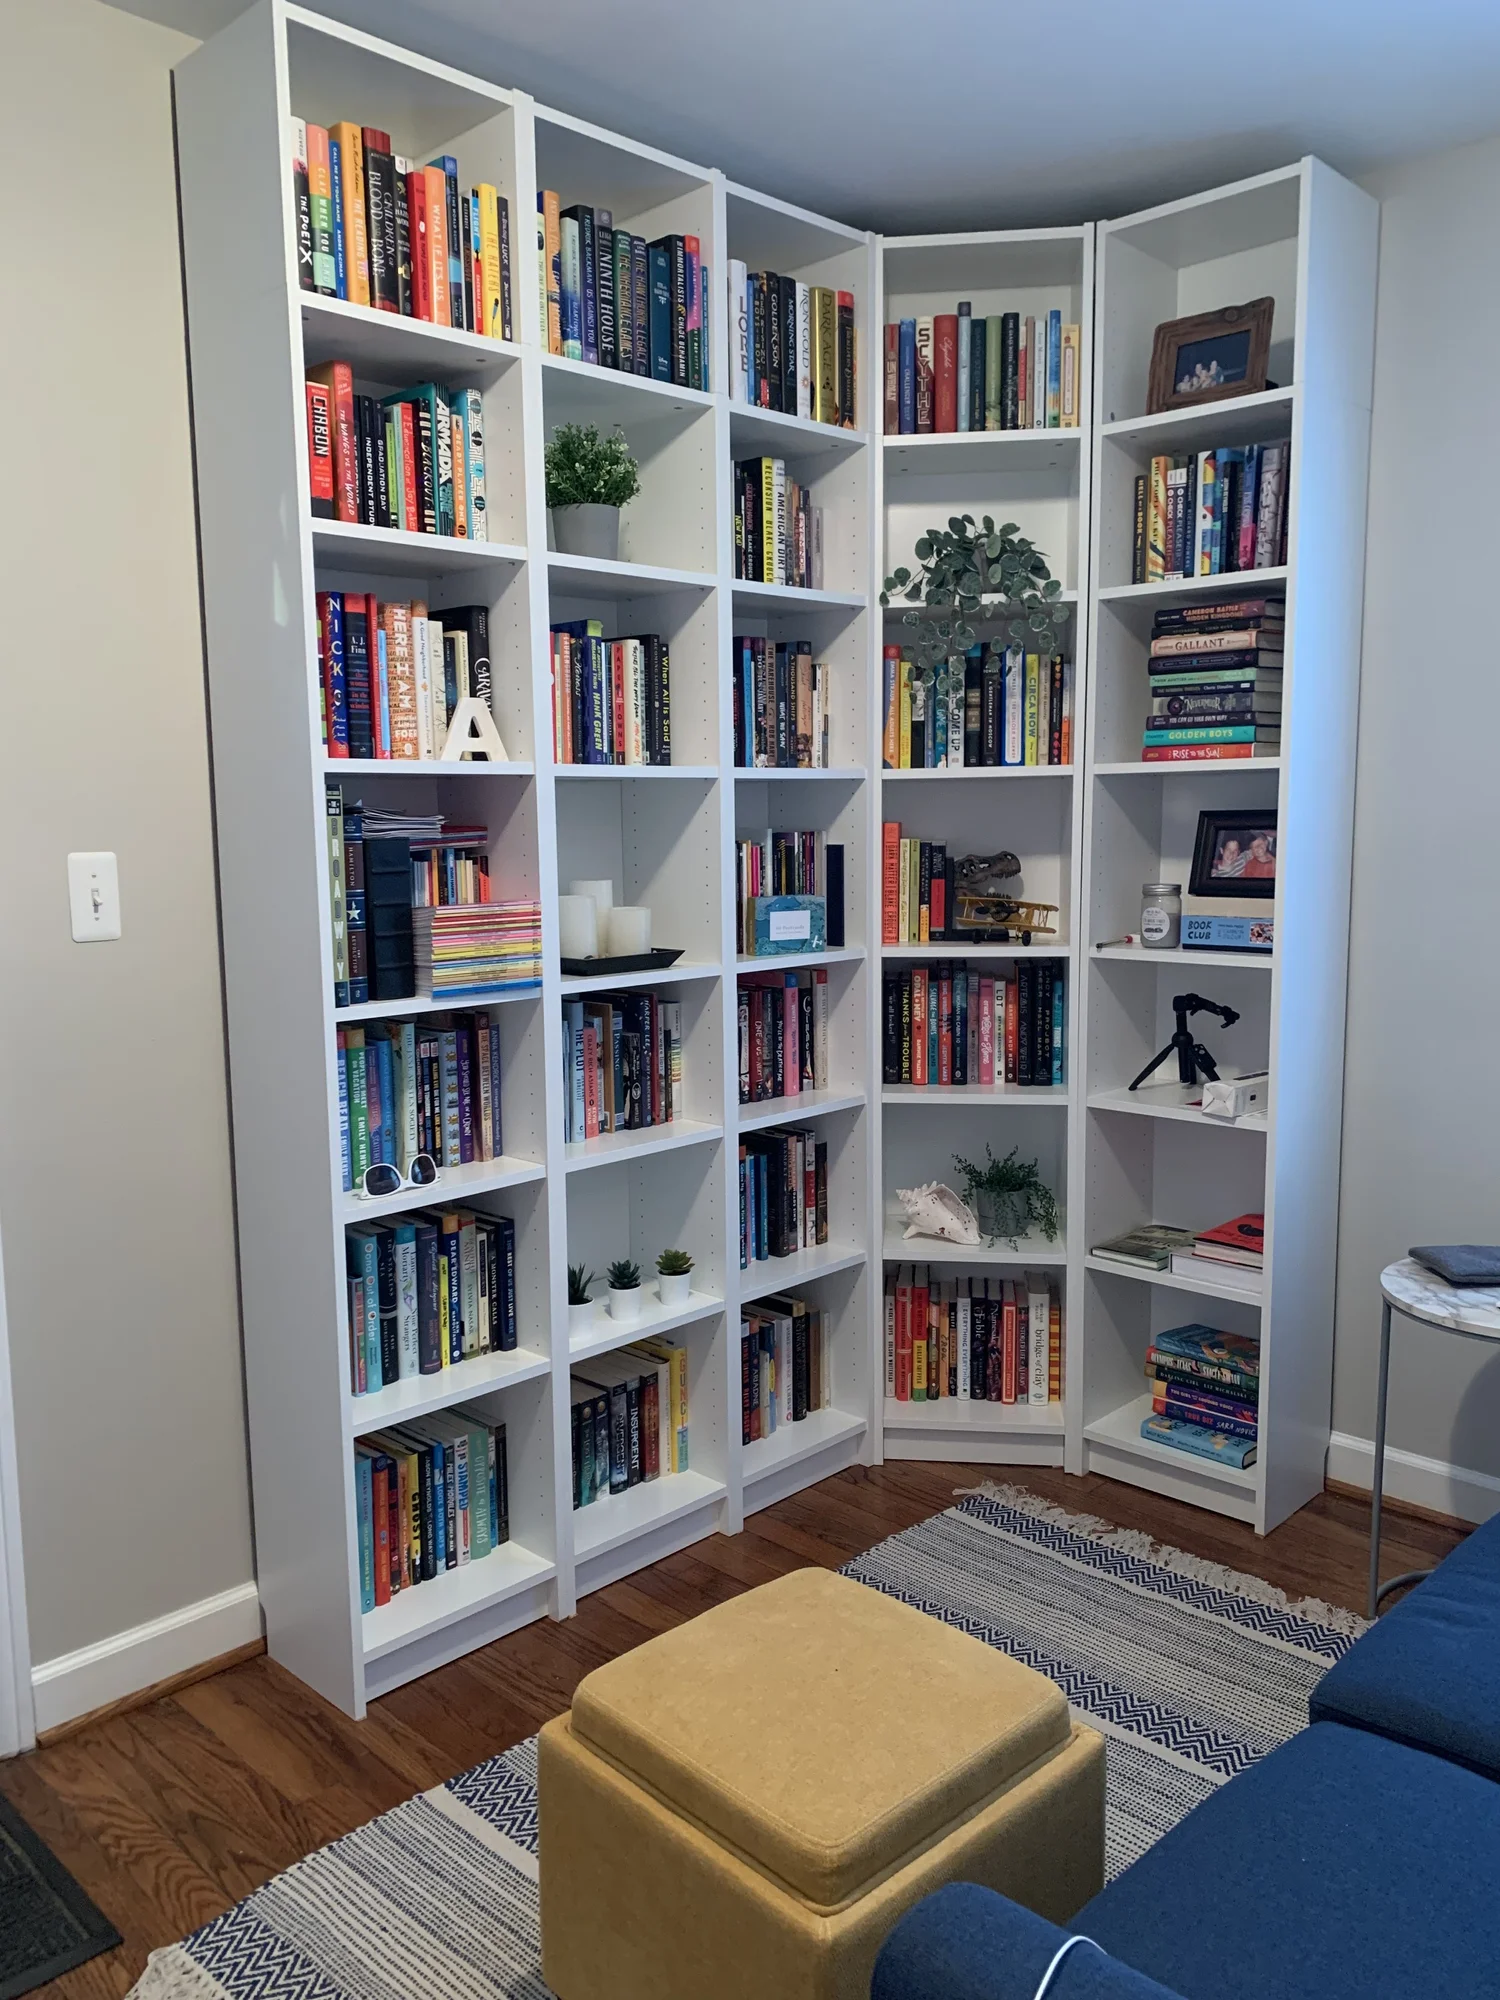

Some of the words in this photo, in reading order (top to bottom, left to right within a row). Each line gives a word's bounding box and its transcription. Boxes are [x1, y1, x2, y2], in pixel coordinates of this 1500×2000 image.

[300, 196, 308, 212] THE
[354, 199, 362, 217] THE
[300, 215, 311, 247] POET
[355, 219, 365, 258] READING
[299, 246, 313, 265] X
[357, 261, 367, 281] LIST
[600, 251, 613, 298] NINTH
[677, 247, 685, 303] IMMORTALISTS
[800, 288, 809, 326] IRON
[822, 293, 832, 334] DARK
[601, 304, 614, 353] HOUSE
[737, 295, 748, 372] LORE
[787, 299, 795, 348] MORNING
[787, 349, 795, 374] STAR
[801, 328, 809, 369] GOLD
[822, 340, 832, 372] AGE
[917, 328, 931, 424] SCYTHE
[313, 395, 330, 456] CHABON
[436, 397, 452, 485] ARMADA
[366, 437, 374, 498] INDEPENDENT
[377, 439, 385, 492] GRADUATION
[421, 441, 433, 504] BLACKOUT
[765, 465, 773, 512] RECURSION
[777, 492, 785, 545] AMERICAN
[1153, 512, 1159, 525] WE
[766, 551, 774, 583] CROUCH
[778, 548, 786, 570] DIRT
[1183, 607, 1215, 617] CAMERON
[1217, 605, 1239, 613] BATTLE
[394, 608, 408, 658] HERE
[1174, 638, 1225, 652] GALLANT
[351, 645, 367, 654] Finn
[396, 662, 410, 677] I
[767, 663, 775, 703] WAREHOUSE
[398, 680, 413, 709] AM
[593, 692, 601, 718] HANK
[1028, 677, 1037, 709] CIRCA
[1184, 696, 1222, 711] NEVERMOOR
[440, 697, 510, 761] A
[593, 720, 602, 750] GREEN
[616, 703, 624, 747] TOWNS
[951, 708, 960, 736] COME
[1028, 712, 1037, 738] NOW
[1168, 731, 1206, 740] GOLDEN
[1209, 729, 1233, 737] BOYS
[951, 738, 960, 752] UP
[348, 847, 356, 888] HAMILTON
[886, 844, 897, 860] DARK
[886, 863, 897, 885] MATTER
[886, 890, 897, 908] BLAKE
[886, 910, 897, 934] CROUCH
[1187, 920, 1213, 930] BOOK
[1187, 931, 1211, 940] CLUB
[902, 986, 910, 1023] THANKS
[1020, 975, 1028, 1014] ARTEMIS
[902, 1036, 910, 1079] TROUBLE
[1020, 1043, 1028, 1070] WEIR
[337, 1059, 347, 1098] BEACH
[352, 1069, 360, 1103] VACATION
[339, 1100, 348, 1130] READ
[358, 1116, 366, 1141] EMILY
[359, 1143, 368, 1171] HENRY
[365, 1243, 373, 1273] Oona
[401, 1246, 409, 1282] Moriarty
[366, 1275, 375, 1293] Out
[450, 1264, 459, 1303] EDWARD
[368, 1295, 376, 1308] of
[368, 1312, 377, 1342] Order
[974, 1306, 985, 1339] Fable
[990, 1303, 999, 1342] Namesake
[752, 1369, 760, 1407] ARIADNE
[1159, 1372, 1184, 1383] DARLING
[1185, 1378, 1200, 1387] GIRL
[1215, 1386, 1248, 1400] MICHALSKI
[630, 1407, 639, 1469] INSURGENT
[1184, 1410, 1200, 1422] TRUE
[1202, 1416, 1214, 1426] BIZ
[1216, 1421, 1235, 1431] SARA
[1235, 1424, 1257, 1437] NOVIĆ
[457, 1461, 469, 1510] STAMPED
[412, 1492, 420, 1541] GHOST
